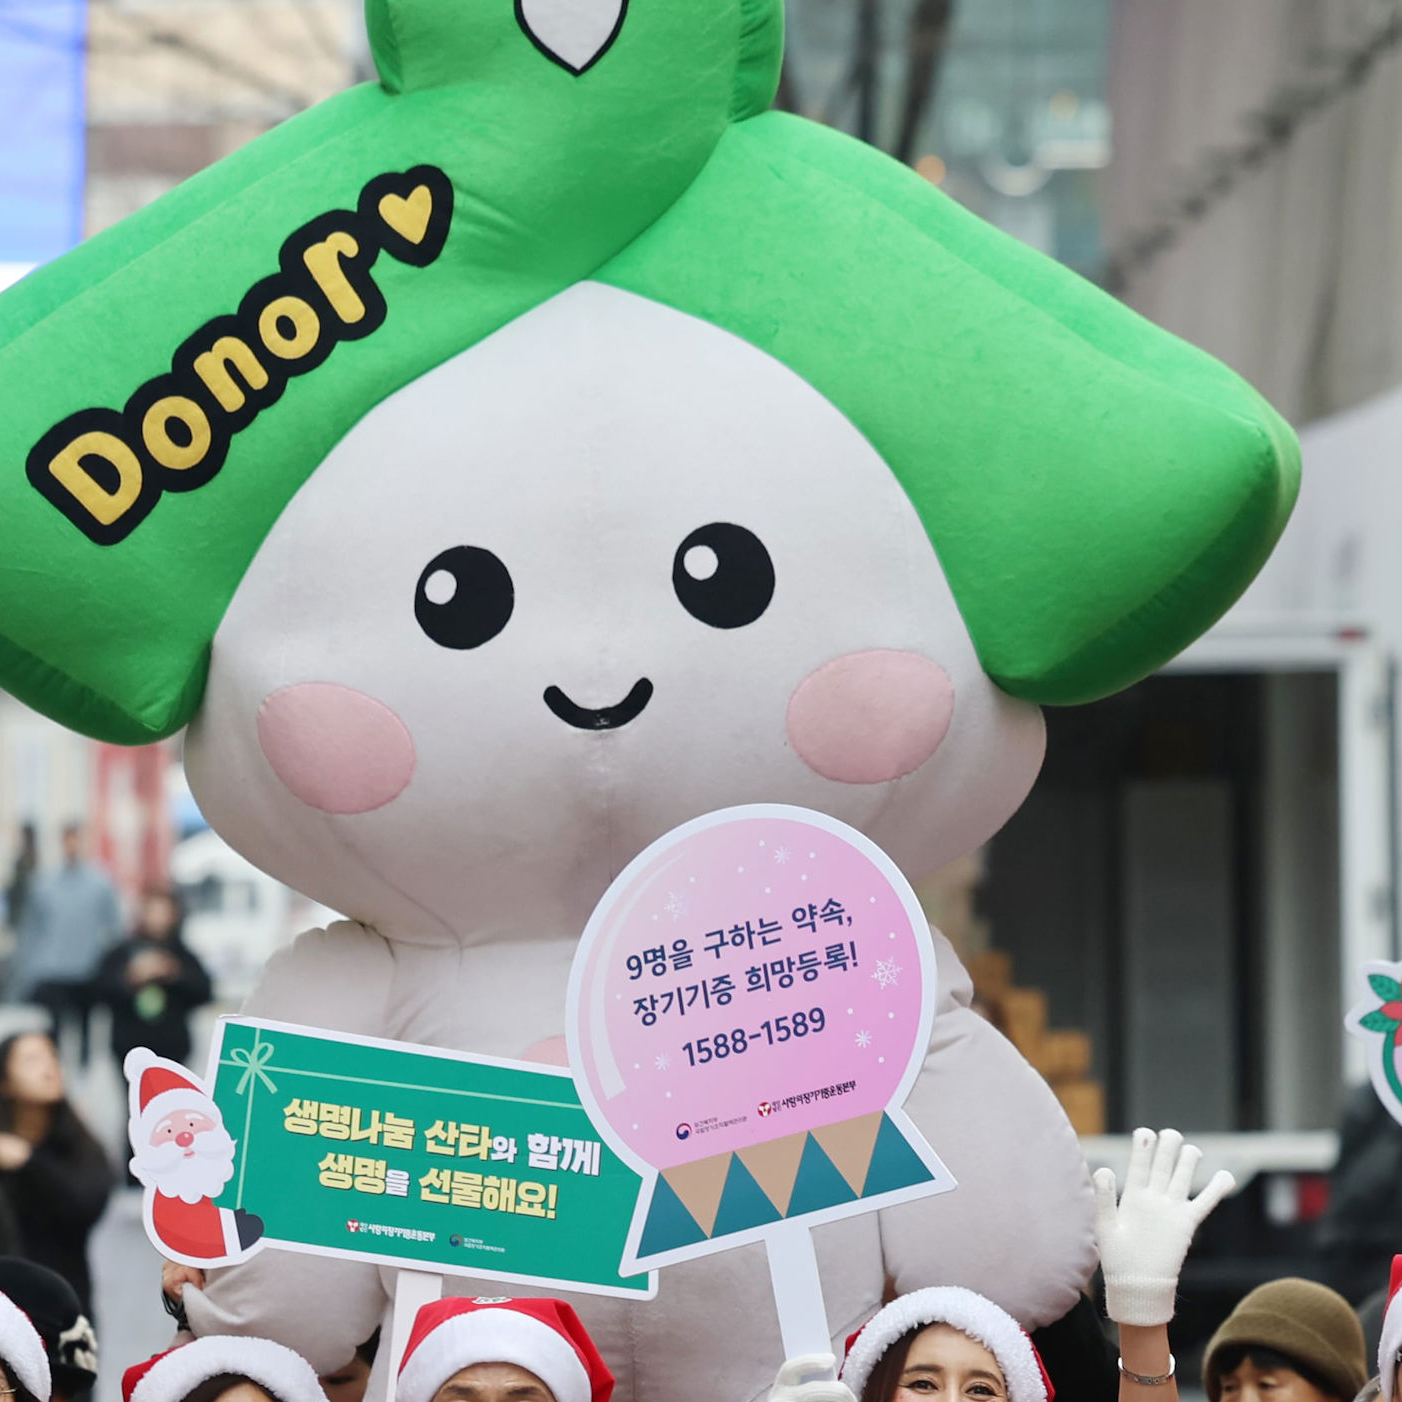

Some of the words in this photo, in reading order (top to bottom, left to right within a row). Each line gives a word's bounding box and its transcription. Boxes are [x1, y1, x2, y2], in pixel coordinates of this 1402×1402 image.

[44, 228, 362, 528] Donor
[626, 938, 694, 980] 9명을
[704, 917, 783, 959] 구하는
[791, 897, 853, 933] 약속,
[633, 974, 736, 1027] 장기기증
[745, 941, 858, 993] 희망등록!
[682, 1006, 826, 1067] 1588-1589
[283, 1097, 416, 1151] 생명나눔
[423, 1118, 518, 1163] 산타와
[526, 1131, 602, 1177] 함께
[317, 1151, 411, 1198] 생명을
[418, 1167, 559, 1220] 선물해요!
